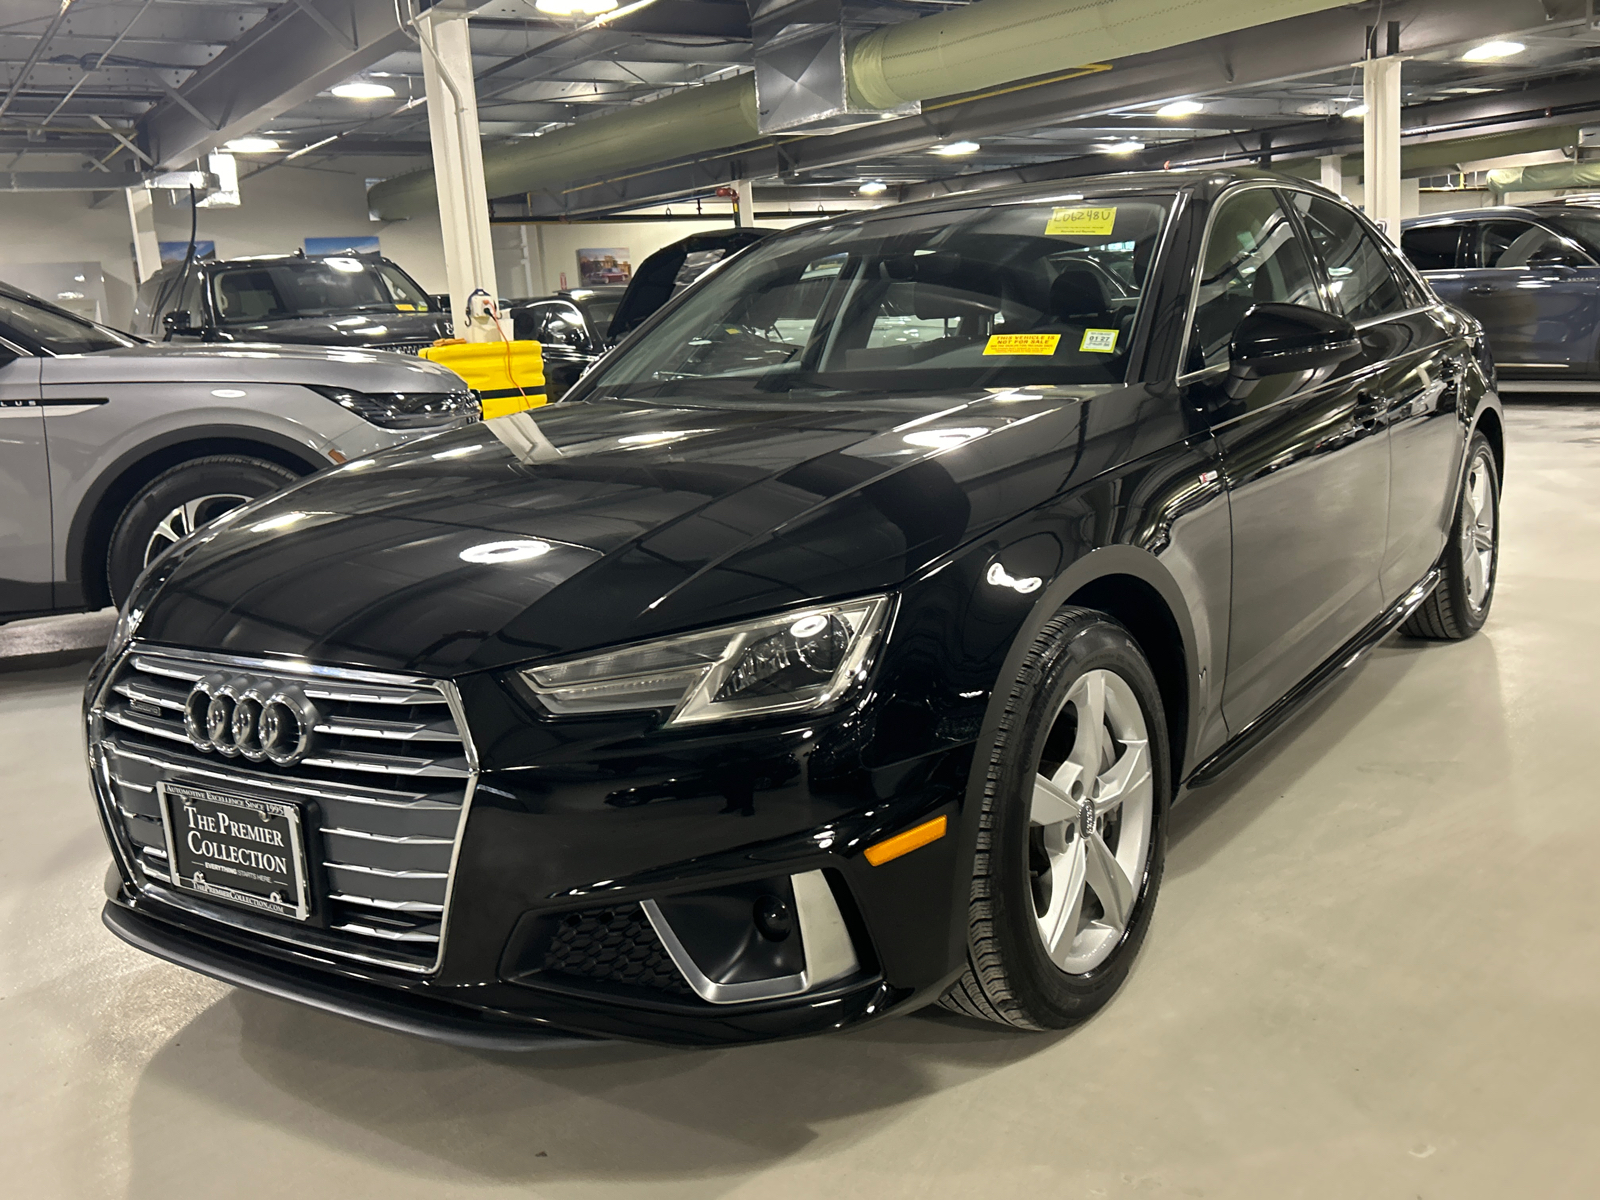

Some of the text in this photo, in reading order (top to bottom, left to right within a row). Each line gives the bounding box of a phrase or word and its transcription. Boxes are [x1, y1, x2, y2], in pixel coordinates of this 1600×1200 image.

[167, 785, 285, 814] AUTOMOTIVE EXCELLENCE SINCE 1995
[184, 805, 284, 847] THE PREMIER
[187, 831, 287, 874] COLLECTION
[205, 862, 237, 875] EVERYTHING
